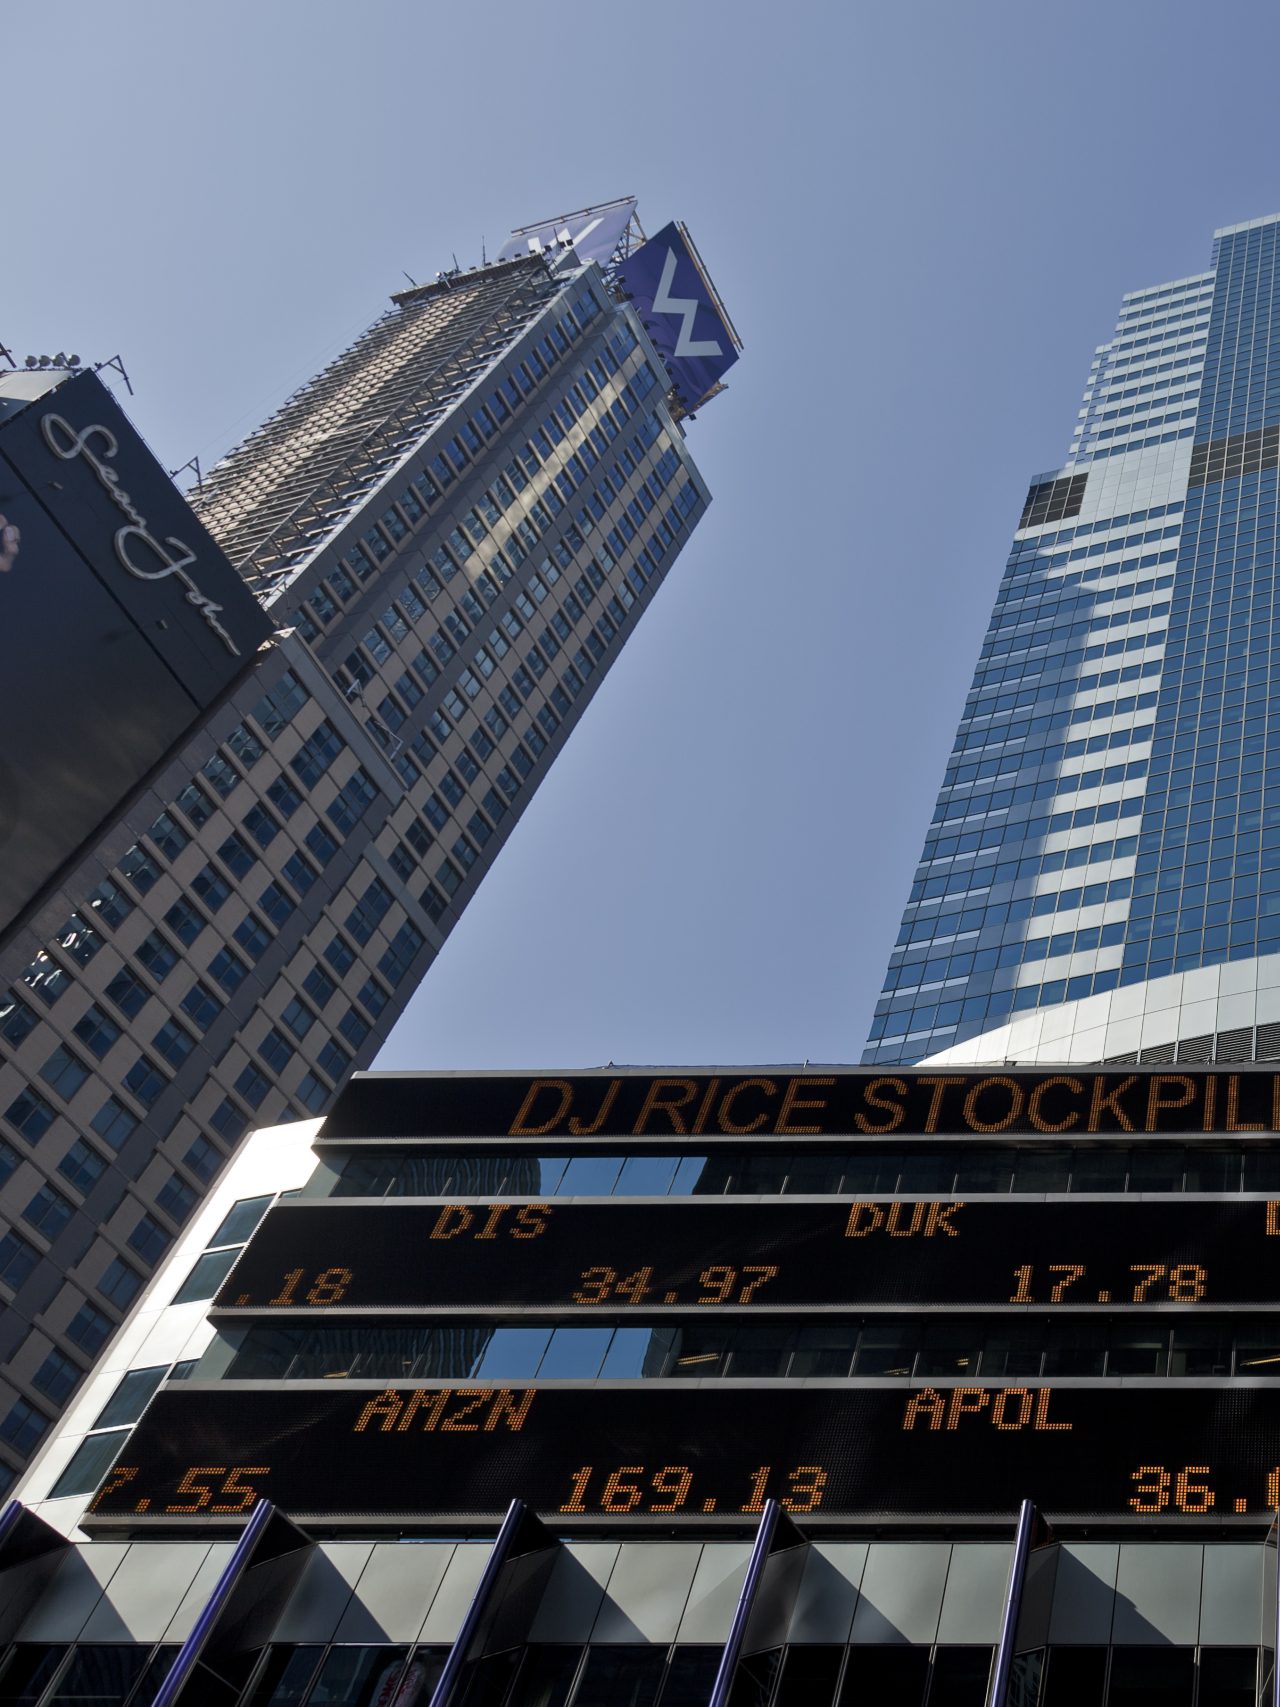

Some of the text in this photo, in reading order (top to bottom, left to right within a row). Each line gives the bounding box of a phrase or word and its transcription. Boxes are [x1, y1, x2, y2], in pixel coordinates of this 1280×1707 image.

[41, 413, 241, 656] Sean John
[507, 1077, 624, 1136] DJ
[632, 1076, 838, 1135] RICE
[429, 1203, 554, 1240] DIS
[843, 1201, 966, 1238] DUK
[570, 1264, 780, 1304] 34.97
[1007, 1263, 1210, 1303] 17.78
[353, 1386, 537, 1432] AMZN
[901, 1386, 1074, 1431] APOL
[558, 1465, 829, 1512] 169.13
